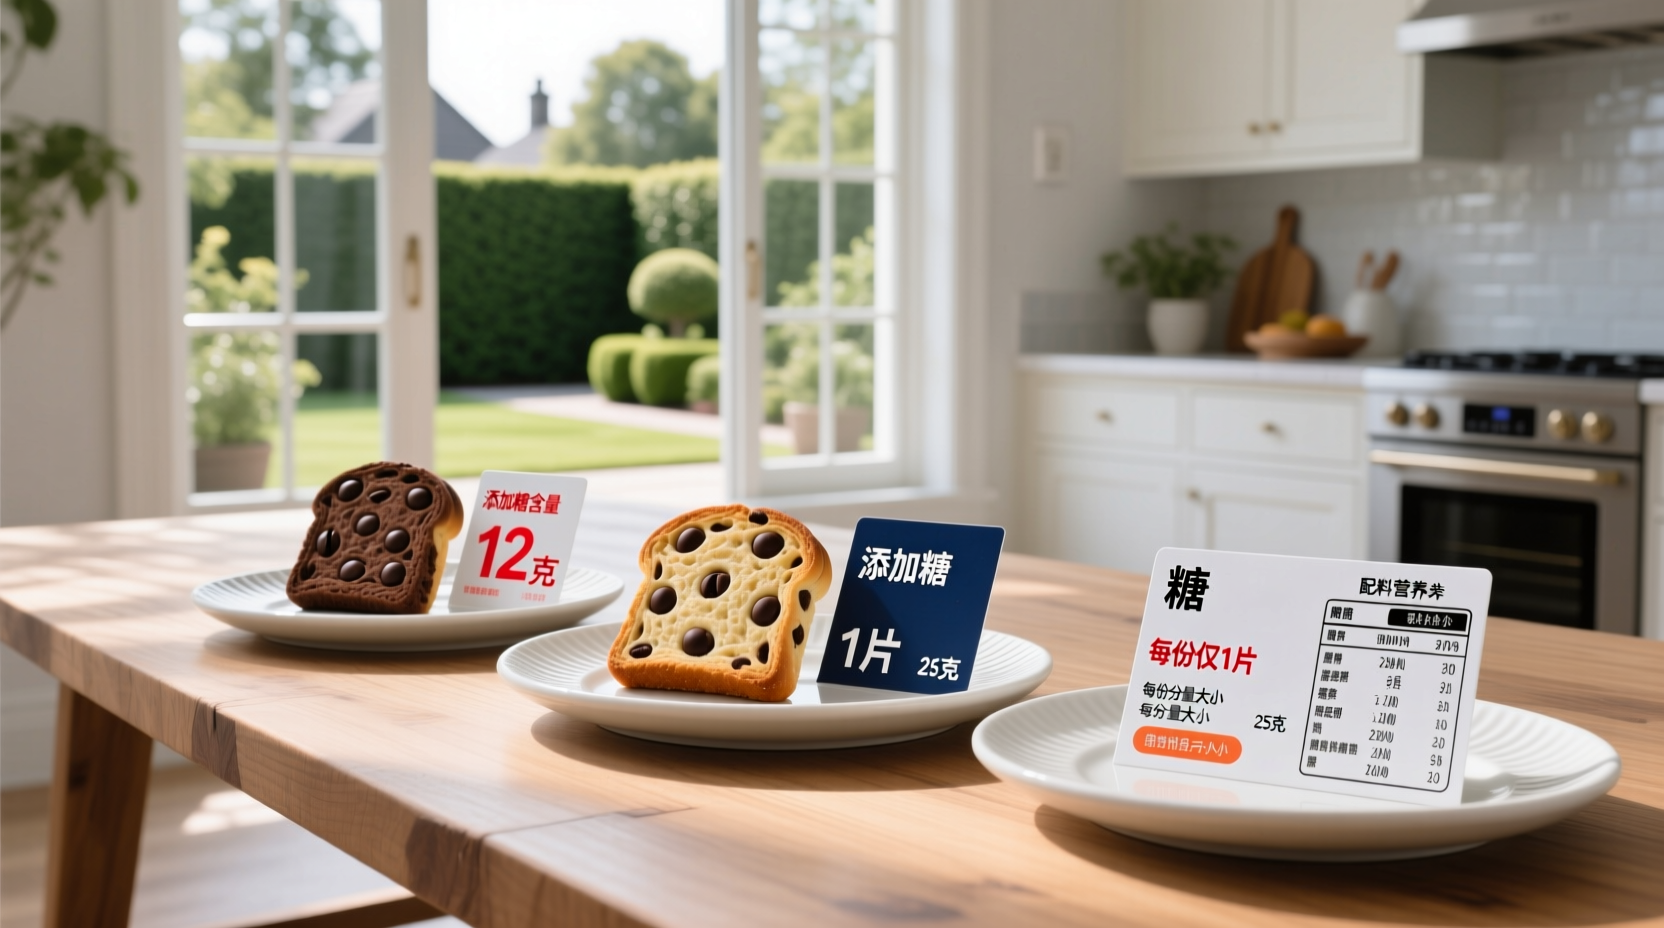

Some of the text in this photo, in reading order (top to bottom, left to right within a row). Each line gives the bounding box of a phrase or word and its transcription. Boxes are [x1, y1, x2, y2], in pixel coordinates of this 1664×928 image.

[482, 489, 561, 514] 添加糖含量
[478, 525, 560, 587] 12克
[857, 546, 954, 587] 添加糖
[1164, 564, 1210, 612] 糖
[841, 627, 962, 681] 1片 25克
[1148, 637, 1258, 675] 每份仅1片
[1253, 714, 1287, 733] 25克
